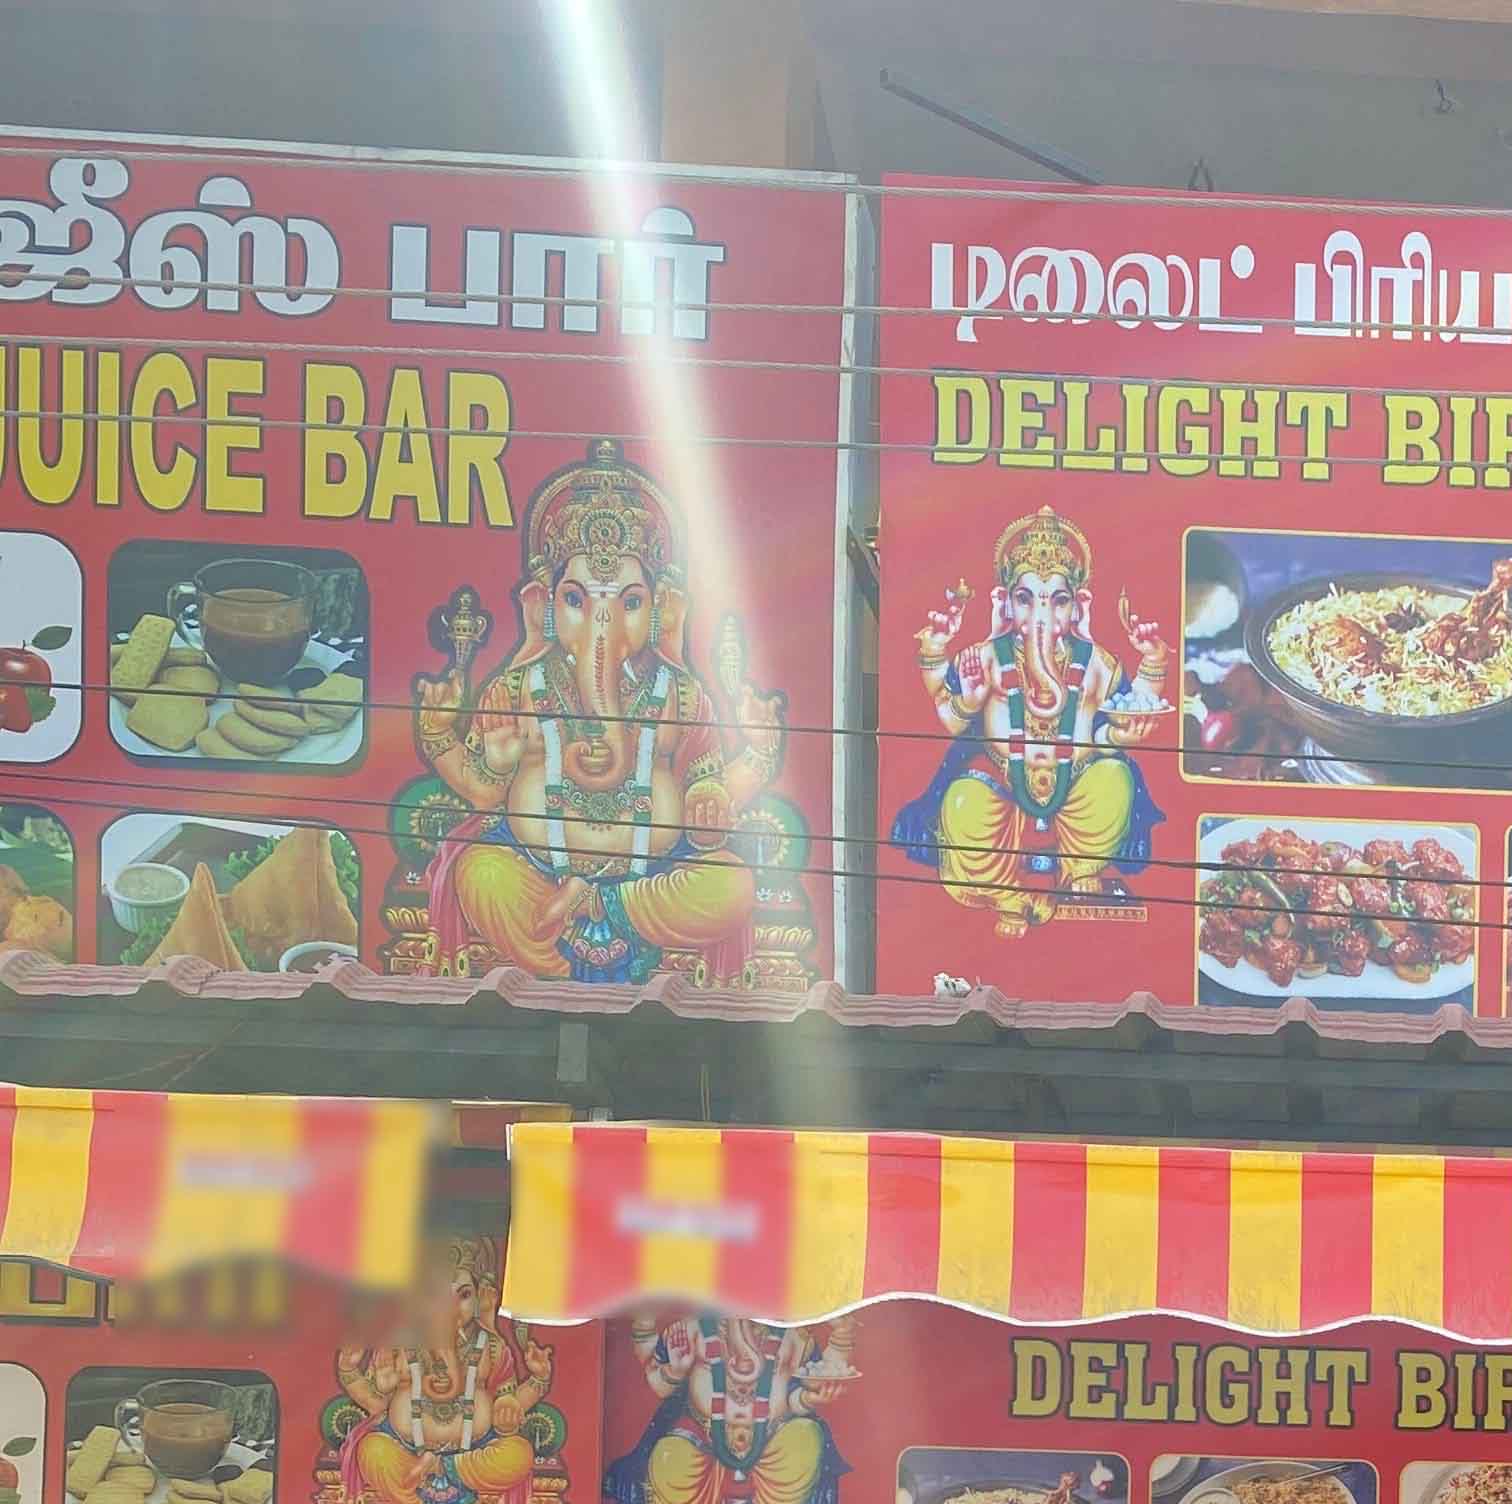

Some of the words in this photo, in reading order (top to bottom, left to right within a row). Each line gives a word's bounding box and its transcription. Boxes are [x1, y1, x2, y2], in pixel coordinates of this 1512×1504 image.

[389, 206, 726, 340] பார்
[931, 242, 1263, 342] டிலைட்
[0, 343, 266, 514] UICE
[303, 361, 516, 527] BAR
[931, 374, 1347, 482] DELIGHT
[1009, 1337, 1369, 1429] DELIGHT
